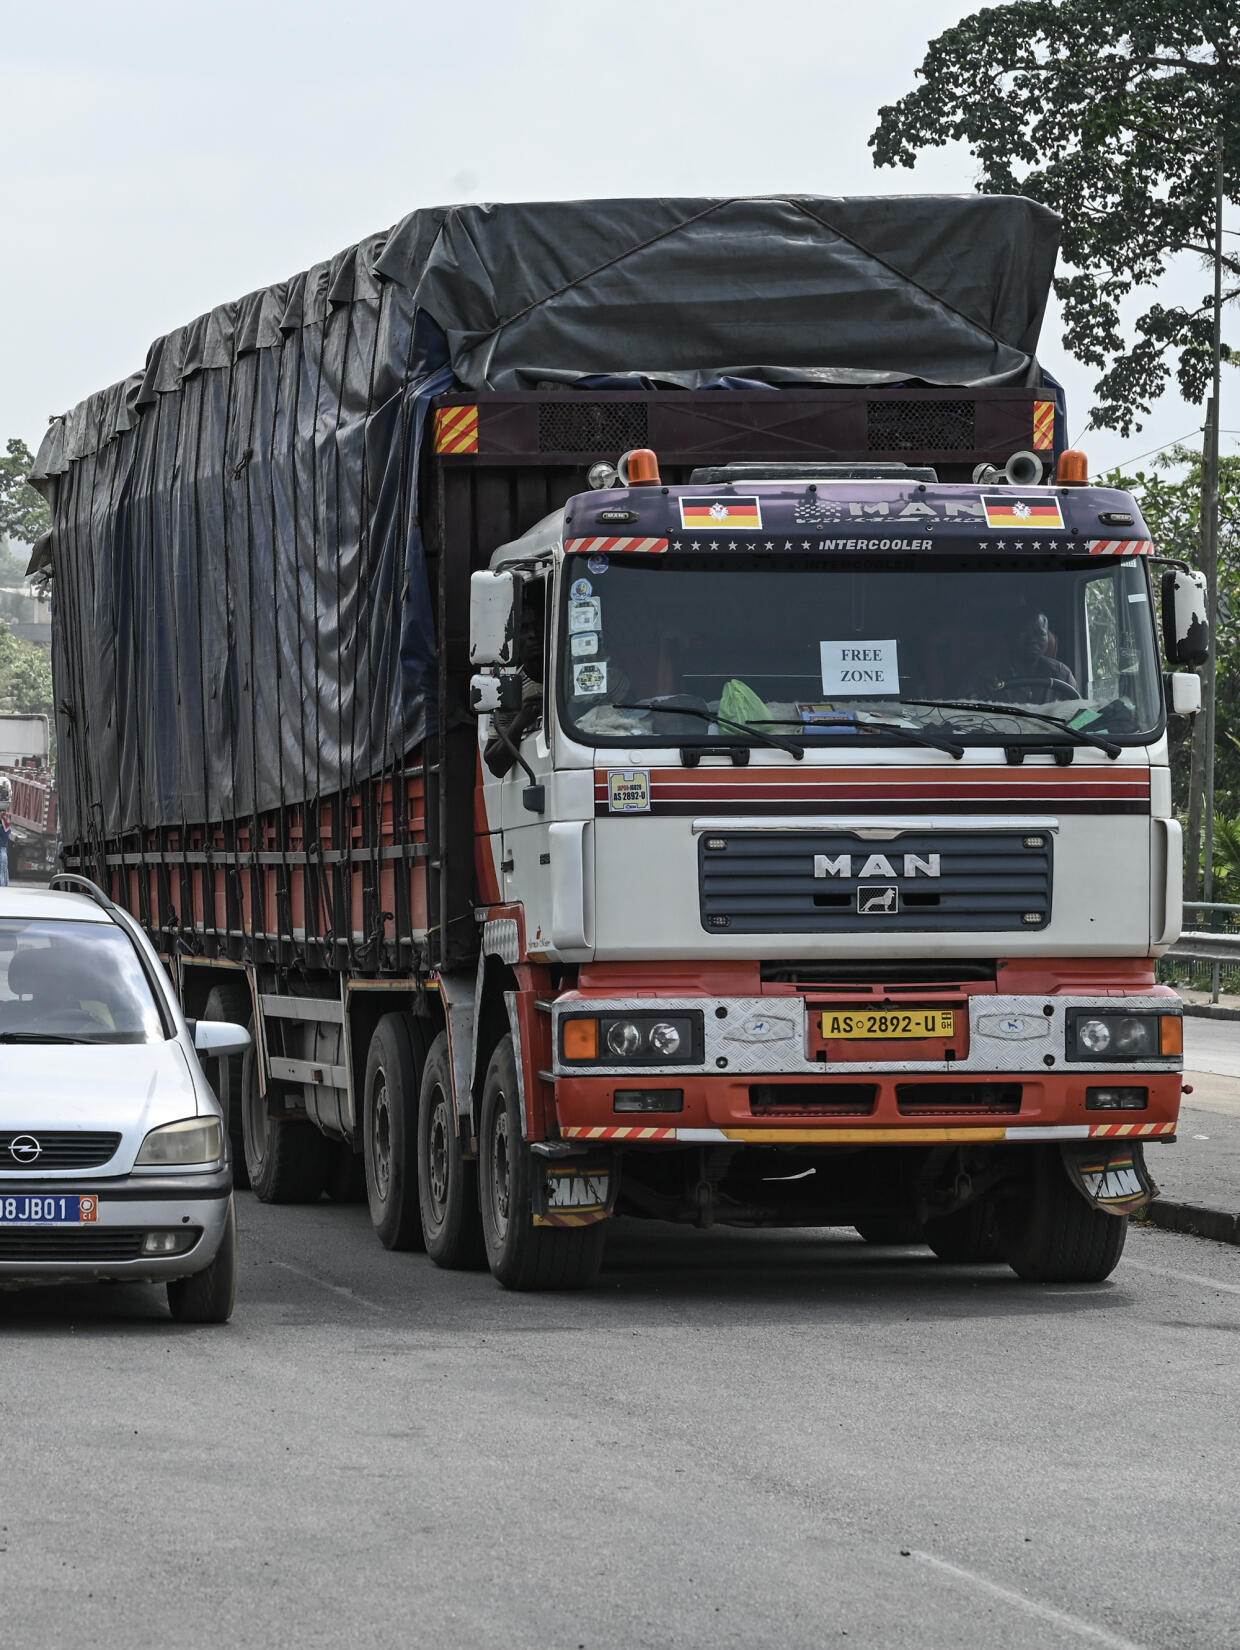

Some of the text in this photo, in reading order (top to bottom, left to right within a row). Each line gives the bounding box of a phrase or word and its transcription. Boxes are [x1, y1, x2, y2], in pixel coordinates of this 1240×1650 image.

[849, 502, 985, 516] MAN
[840, 649, 885, 682] FREE ZONE
[614, 791, 646, 801] AS 2892-U
[814, 853, 941, 878] MAN
[830, 1015, 936, 1034] AS 2892-U
[941, 1021, 952, 1030] GH
